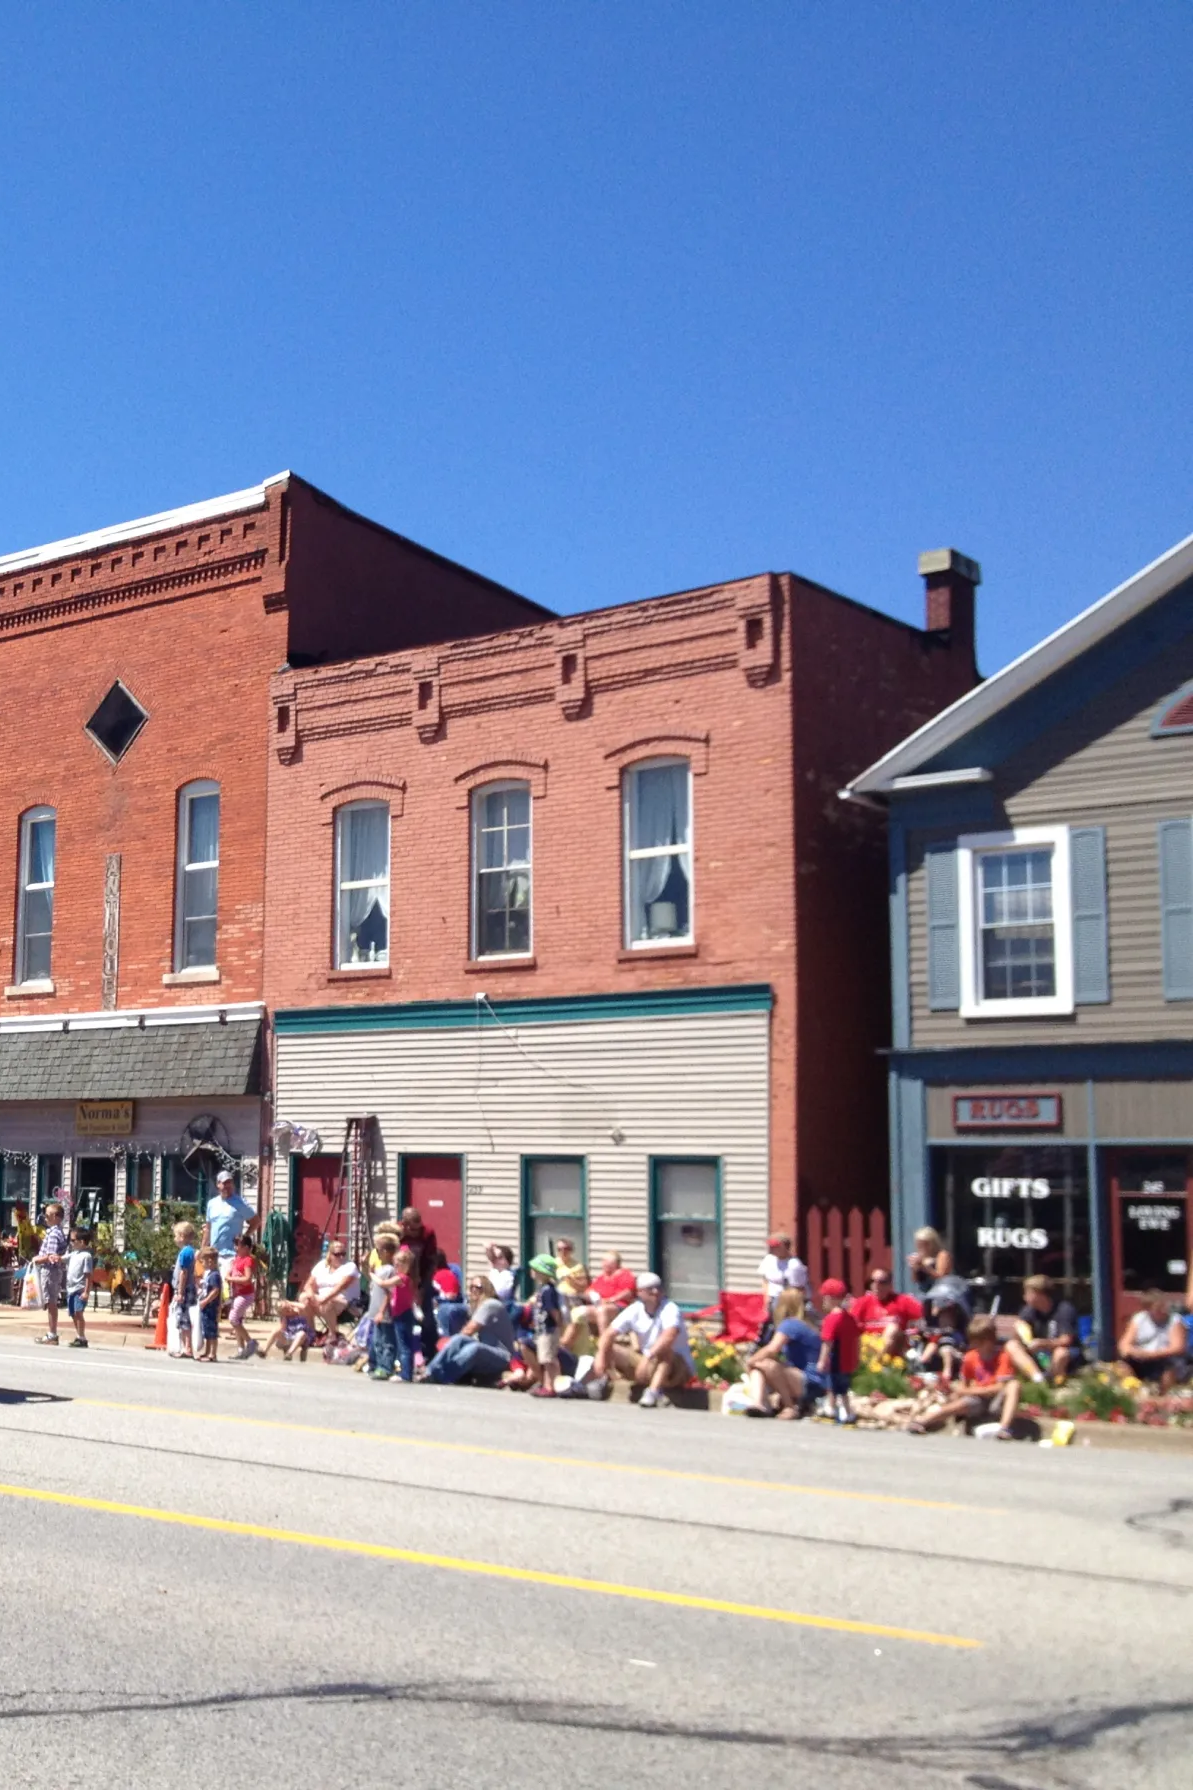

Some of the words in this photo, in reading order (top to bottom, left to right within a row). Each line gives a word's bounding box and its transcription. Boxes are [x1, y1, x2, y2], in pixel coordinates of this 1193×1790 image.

[80, 1104, 130, 1119] Norma's
[969, 1099, 1040, 1119] RUGS
[971, 1177, 1050, 1199] GIFTS
[977, 1227, 1049, 1249] RUGS
